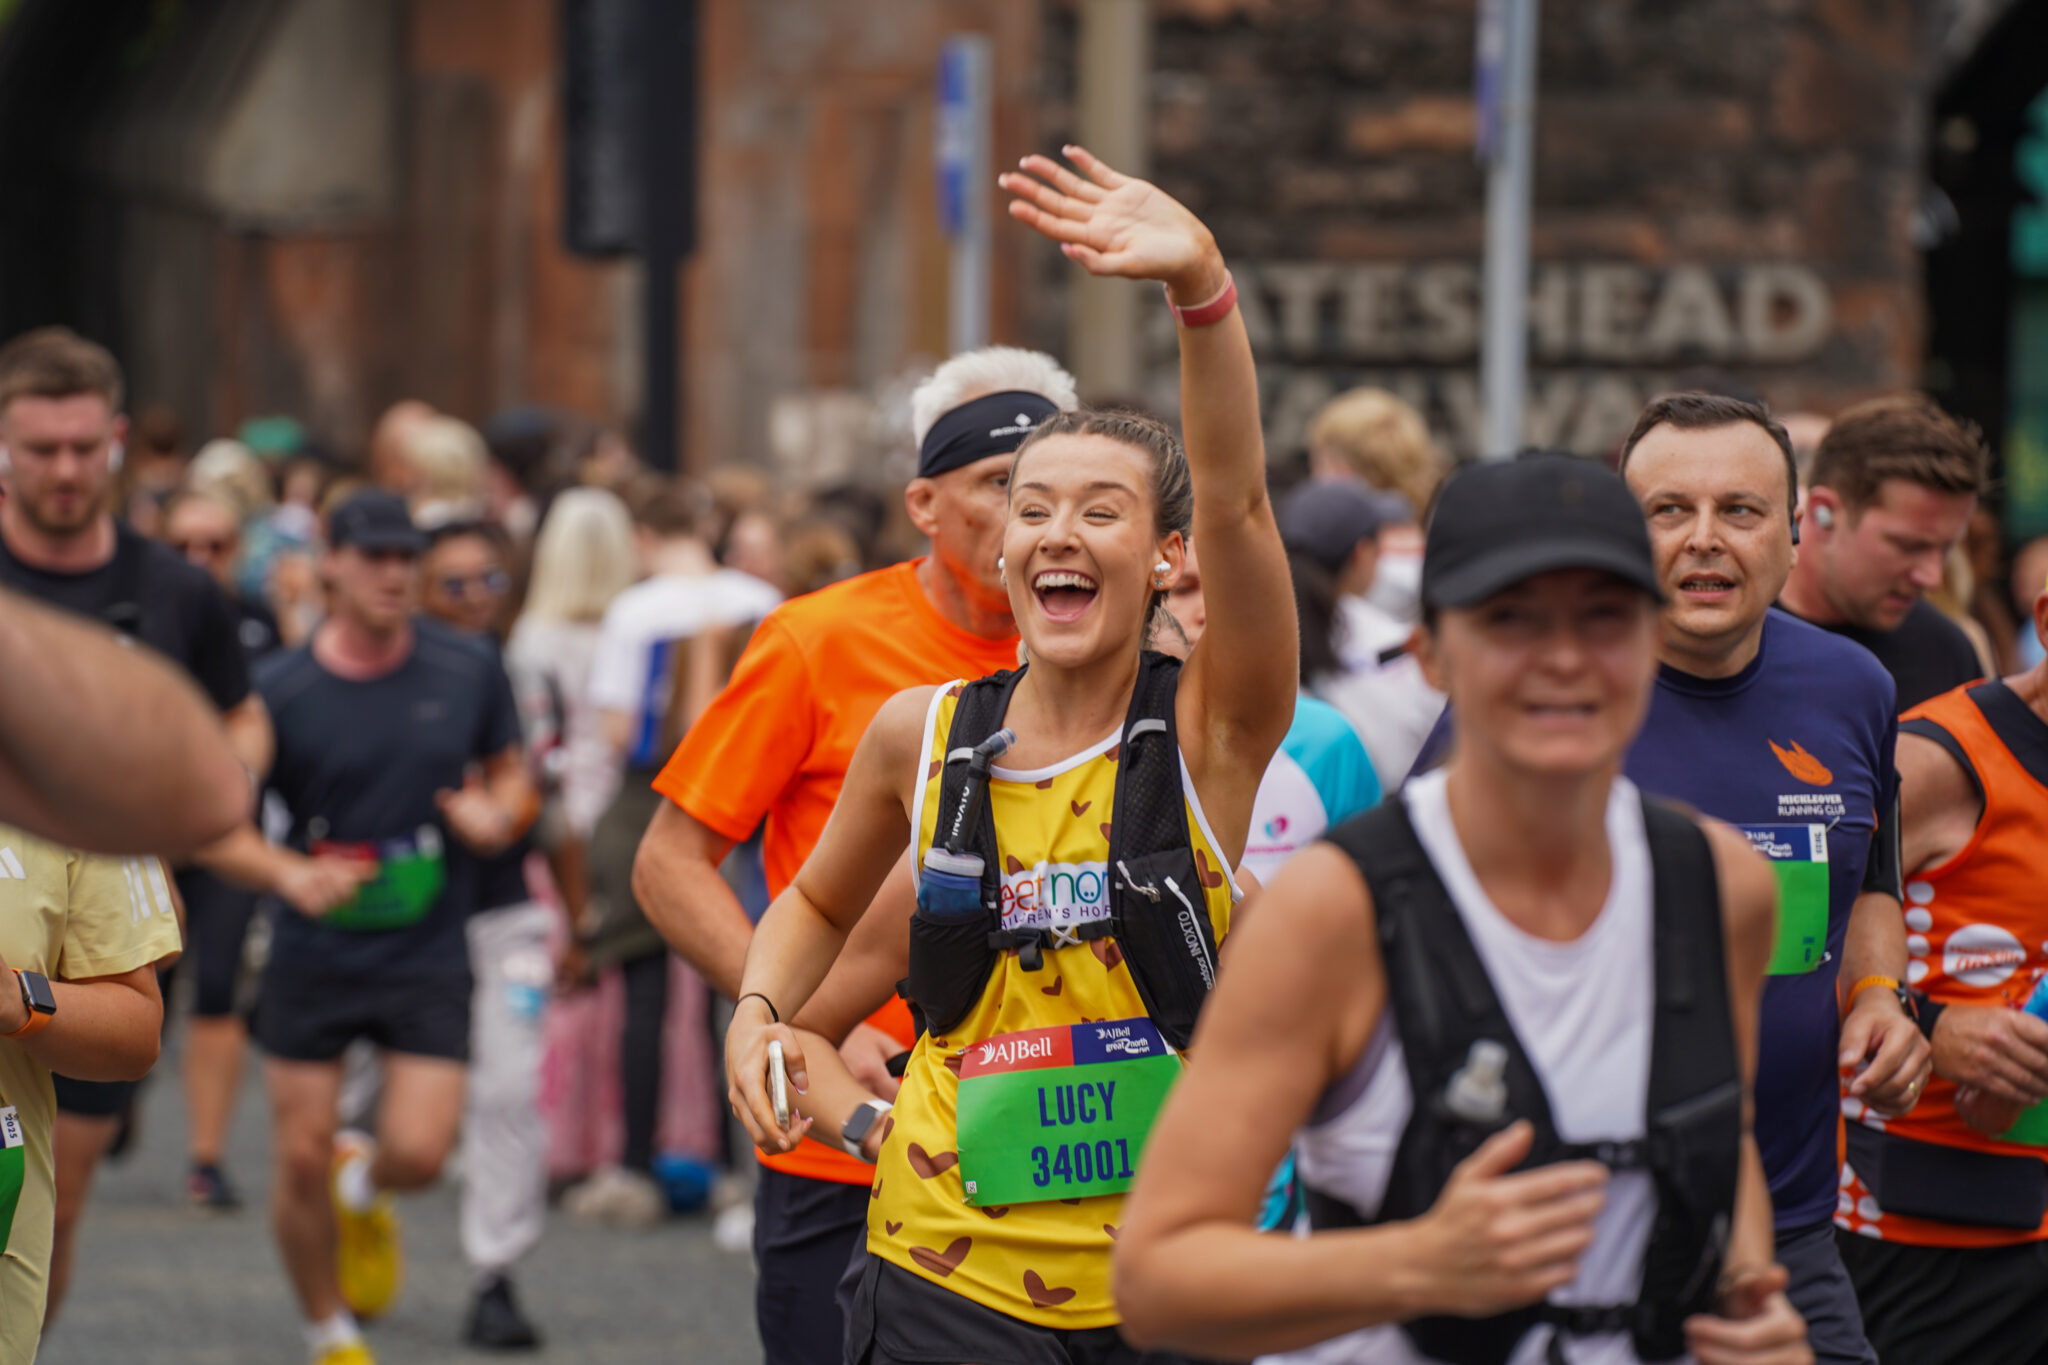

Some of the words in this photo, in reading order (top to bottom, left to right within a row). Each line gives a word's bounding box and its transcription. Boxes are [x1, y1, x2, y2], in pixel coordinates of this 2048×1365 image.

[1778, 805, 1824, 816] RUNNING
[1825, 804, 1846, 816] CLUB
[1177, 911, 1203, 957] INOXTO
[5, 1113, 18, 1139] 2025
[1037, 1080, 1116, 1127] LUCY
[1031, 1138, 1135, 1187] 34001
